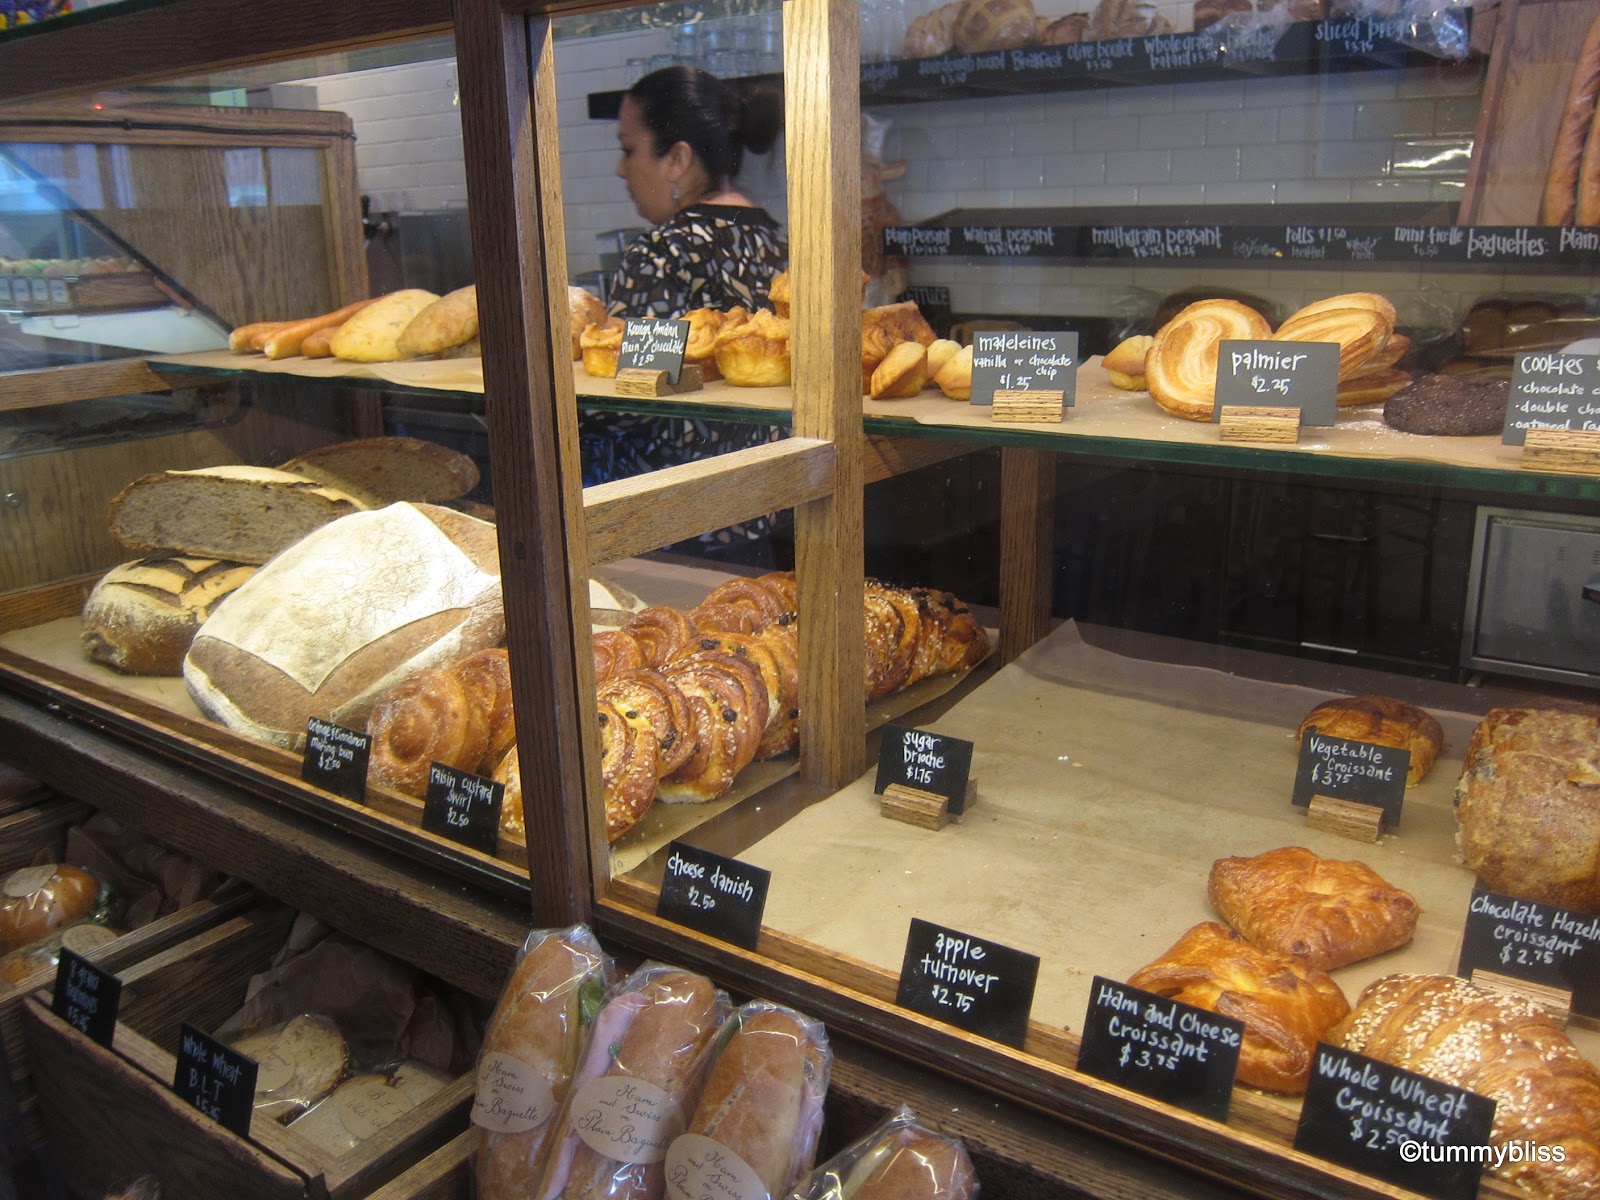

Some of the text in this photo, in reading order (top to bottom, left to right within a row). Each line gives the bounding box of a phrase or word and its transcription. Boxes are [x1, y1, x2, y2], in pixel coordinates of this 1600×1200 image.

[1315, 18, 1360, 41] sliced
[1144, 34, 1181, 56] whole
[1166, 226, 1222, 250] peasant
[1285, 226, 1315, 245] rolls
[979, 333, 1056, 353] madeleines
[973, 353, 1072, 369] vanilla or chocolate
[1035, 365, 1058, 381] chip
[1232, 348, 1308, 376] palmier
[999, 373, 1033, 391] $1.25
[1251, 375, 1291, 396] $2.25
[1522, 381, 1585, 396] chocolate
[1519, 399, 1570, 414] double
[902, 731, 942, 752] sugar
[1310, 736, 1383, 765] Vegetable
[903, 744, 945, 769] brioche
[905, 764, 934, 784] $1.75
[1311, 762, 1353, 788] $3.75
[1327, 757, 1393, 783] Croissant
[430, 766, 495, 805] raisin custard
[447, 788, 473, 813] swirl
[667, 851, 754, 903] cheese danish
[688, 885, 716, 910] $2.50
[1470, 894, 1544, 928] Chocolate
[934, 932, 987, 965] apple
[920, 952, 1000, 994] turnover
[931, 983, 975, 1013] $2.75
[1096, 984, 1241, 1048] Ham and Cheese
[1108, 1016, 1209, 1063] Croissant
[1119, 1042, 1180, 1071] $3.75
[488, 1060, 519, 1080] Ham
[616, 1084, 658, 1106] Ham
[1319, 1052, 1468, 1120] Whole Wheat
[485, 1098, 540, 1125] Baguette
[578, 1109, 616, 1137] Plain
[599, 1099, 661, 1123] and Swiss
[1336, 1086, 1450, 1146] Croissant
[704, 1151, 743, 1183] Ham
